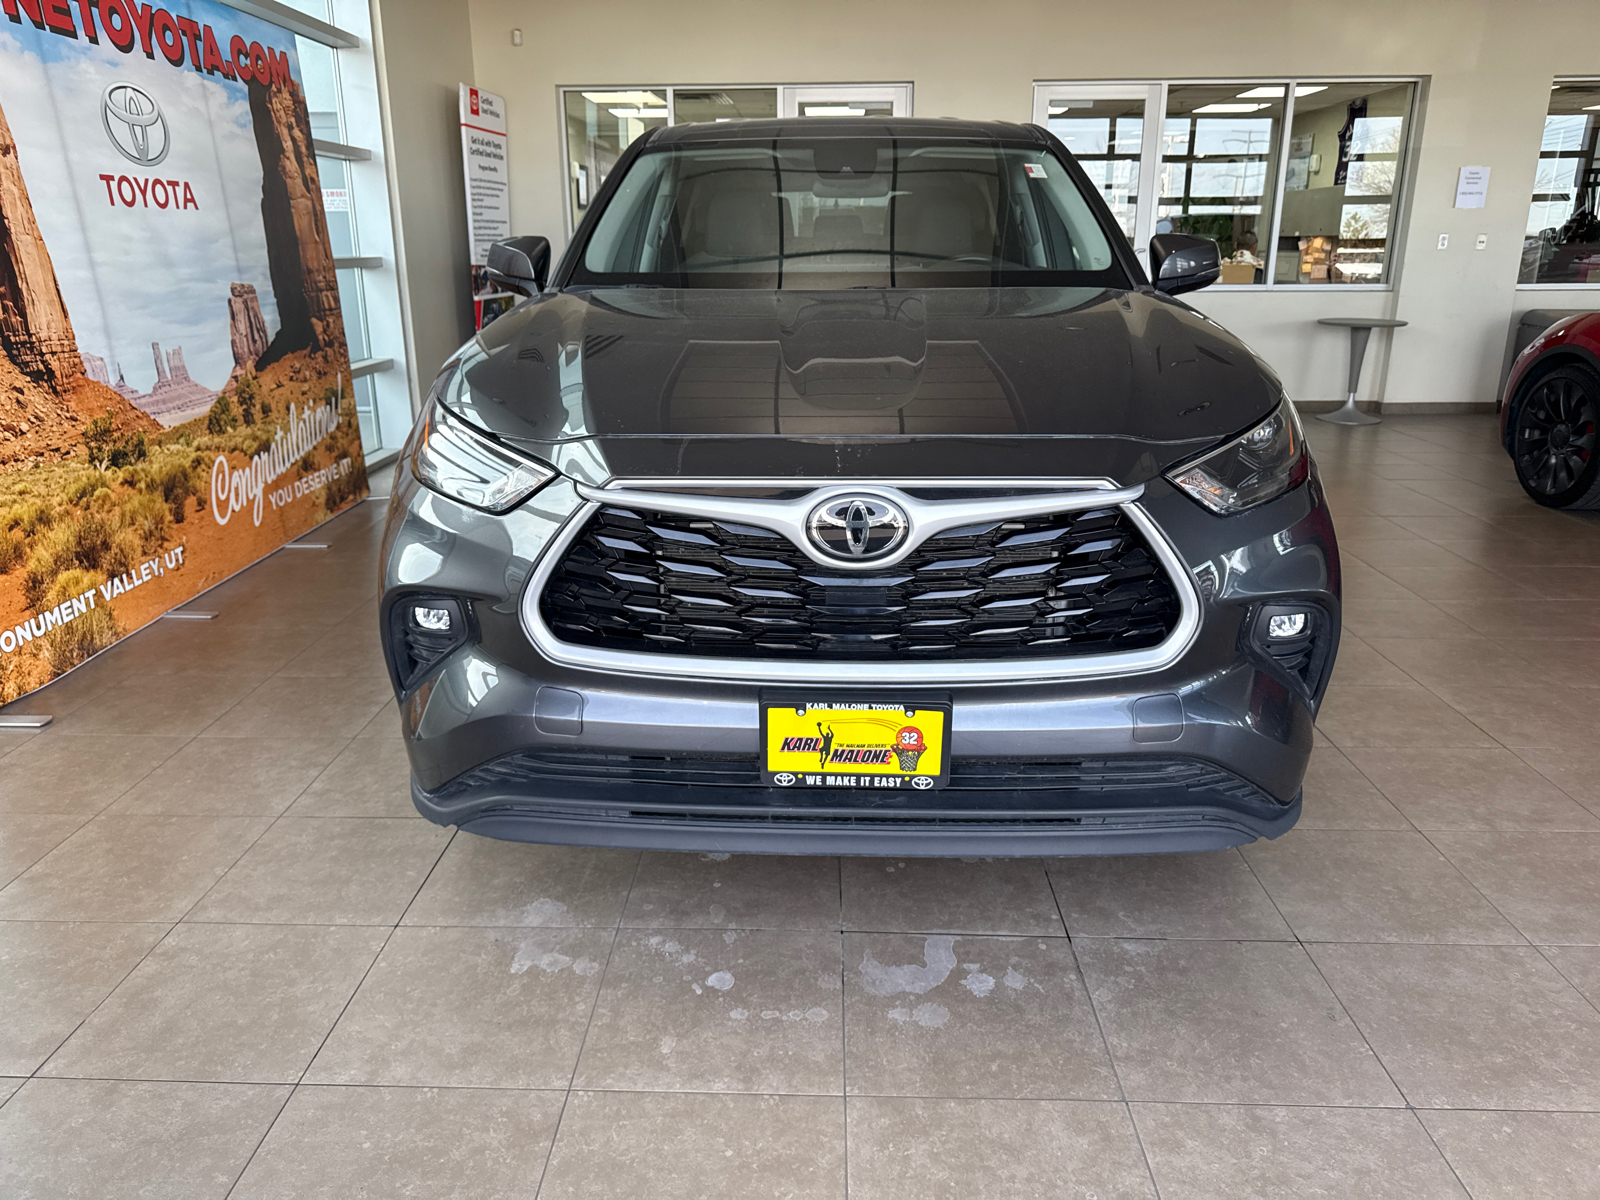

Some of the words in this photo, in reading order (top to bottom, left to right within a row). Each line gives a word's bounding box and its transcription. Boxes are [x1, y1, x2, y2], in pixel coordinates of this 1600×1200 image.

[98, 173, 200, 211] TOYOTA
[211, 372, 343, 528] Congratulations!
[268, 485, 293, 510] YOU
[294, 465, 339, 498] DESERVE
[339, 456, 353, 477] IT!
[0, 588, 96, 657] ONUMENT
[99, 557, 164, 602] VALLEY,
[164, 545, 184, 570] UT
[806, 702, 830, 711] KARL
[832, 703, 869, 711] MALONE
[871, 704, 905, 712] TOYOTA
[780, 737, 822, 752] KARL
[901, 732, 918, 745] 32
[829, 748, 893, 765] MALONE
[805, 775, 822, 786] WE
[826, 775, 858, 786] MAKE
[860, 776, 870, 787] IT
[872, 777, 901, 788] EASY
